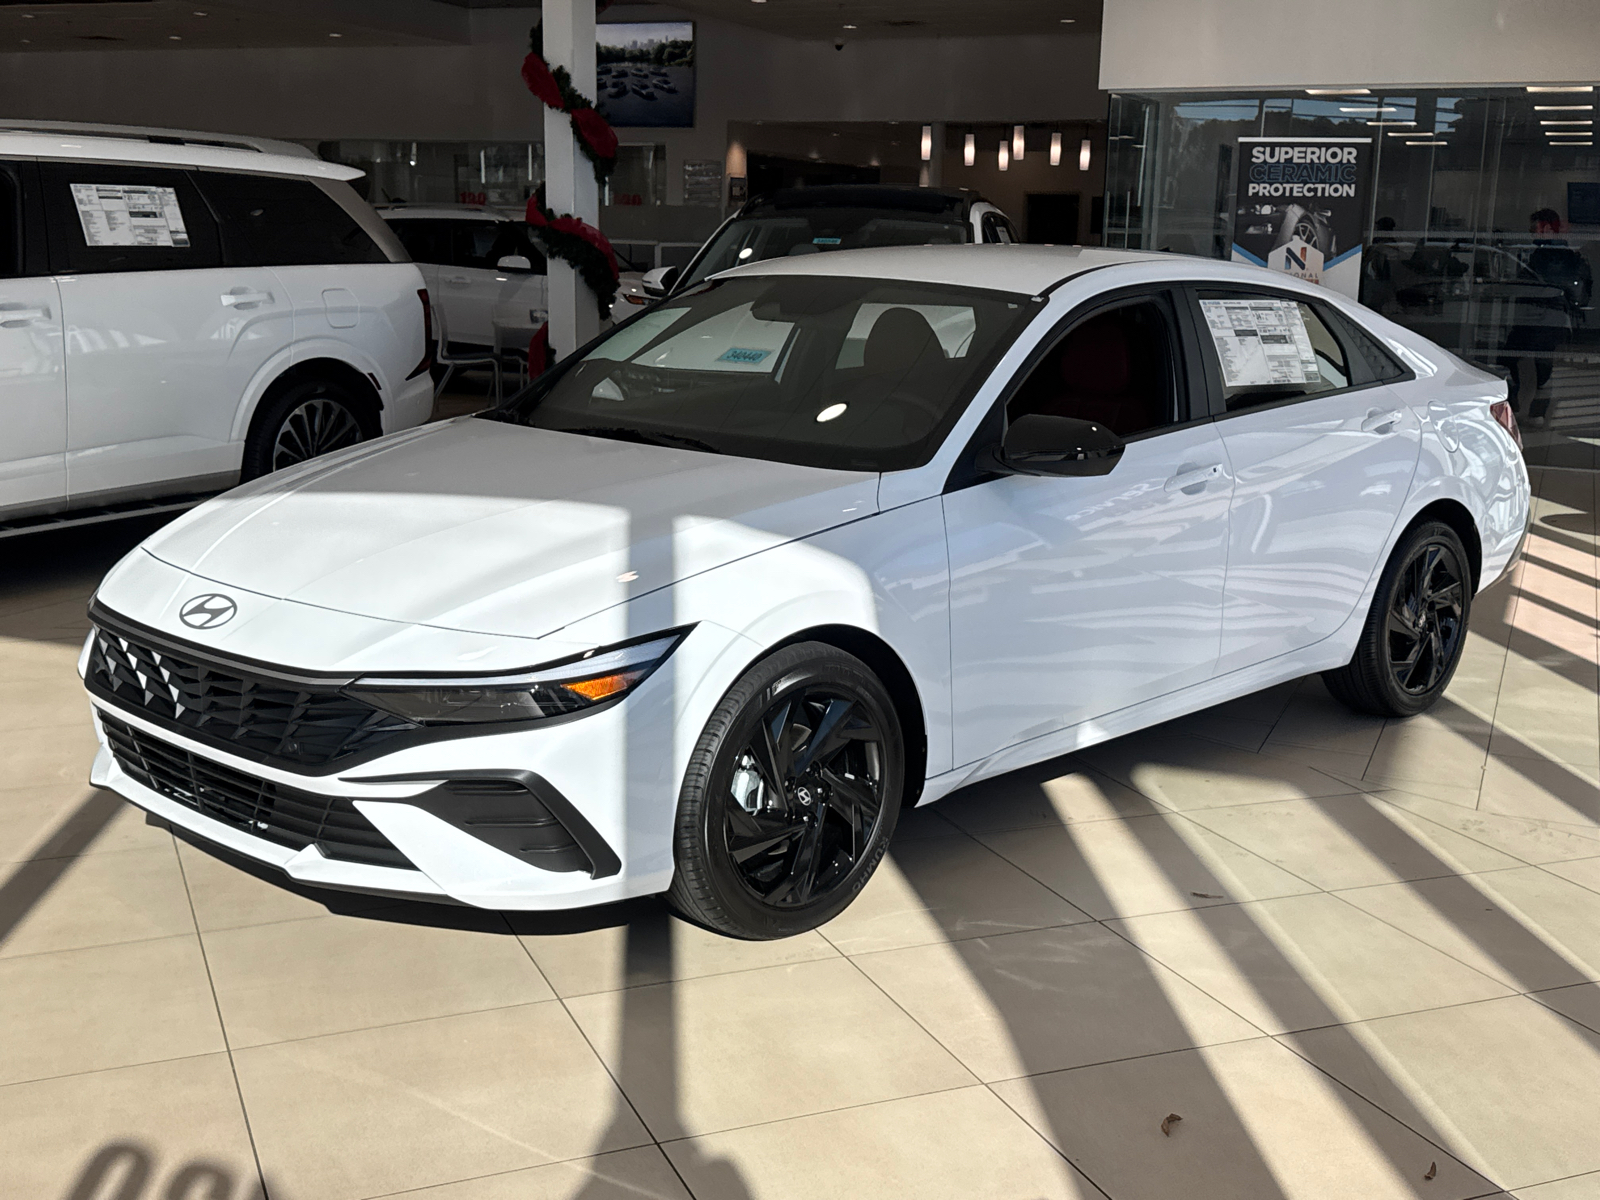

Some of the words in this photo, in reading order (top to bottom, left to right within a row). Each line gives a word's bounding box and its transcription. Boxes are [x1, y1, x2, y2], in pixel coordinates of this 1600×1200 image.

[1251, 146, 1357, 164] SUPERIOR
[1250, 164, 1357, 183] CERAMIC
[1248, 183, 1356, 197] PROTECTION
[1284, 246, 1307, 271] N
